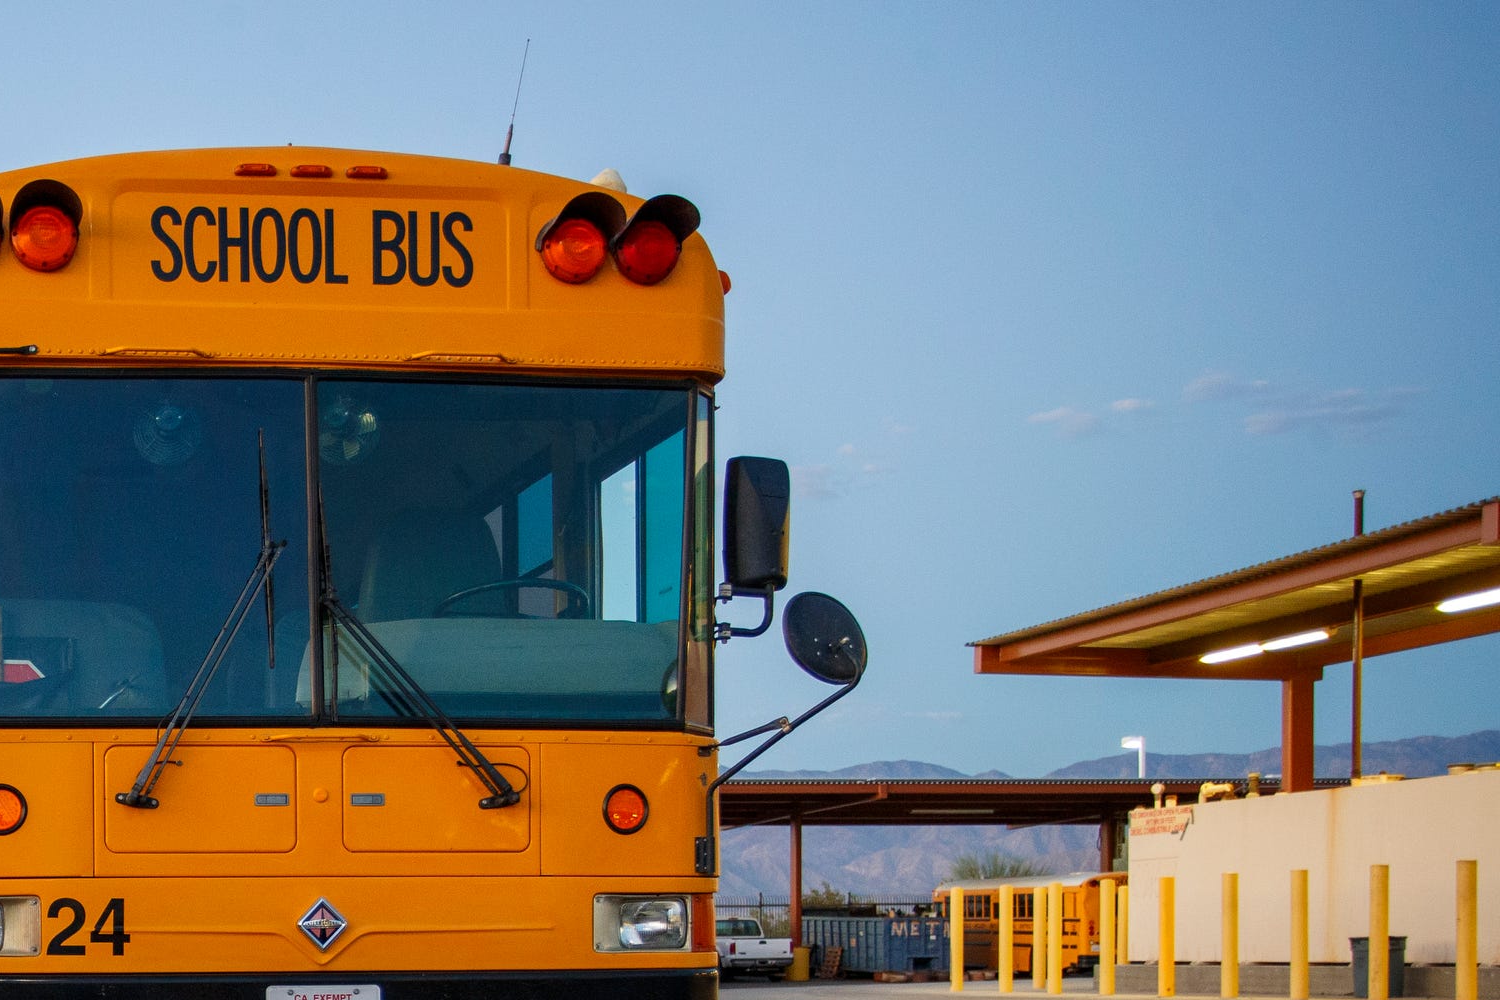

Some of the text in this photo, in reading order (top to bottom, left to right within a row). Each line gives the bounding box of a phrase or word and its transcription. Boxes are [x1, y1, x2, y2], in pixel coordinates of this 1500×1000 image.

[150, 205, 474, 288] SCHOOL BUS
[46, 897, 131, 956] 24
[891, 920, 950, 938] META
